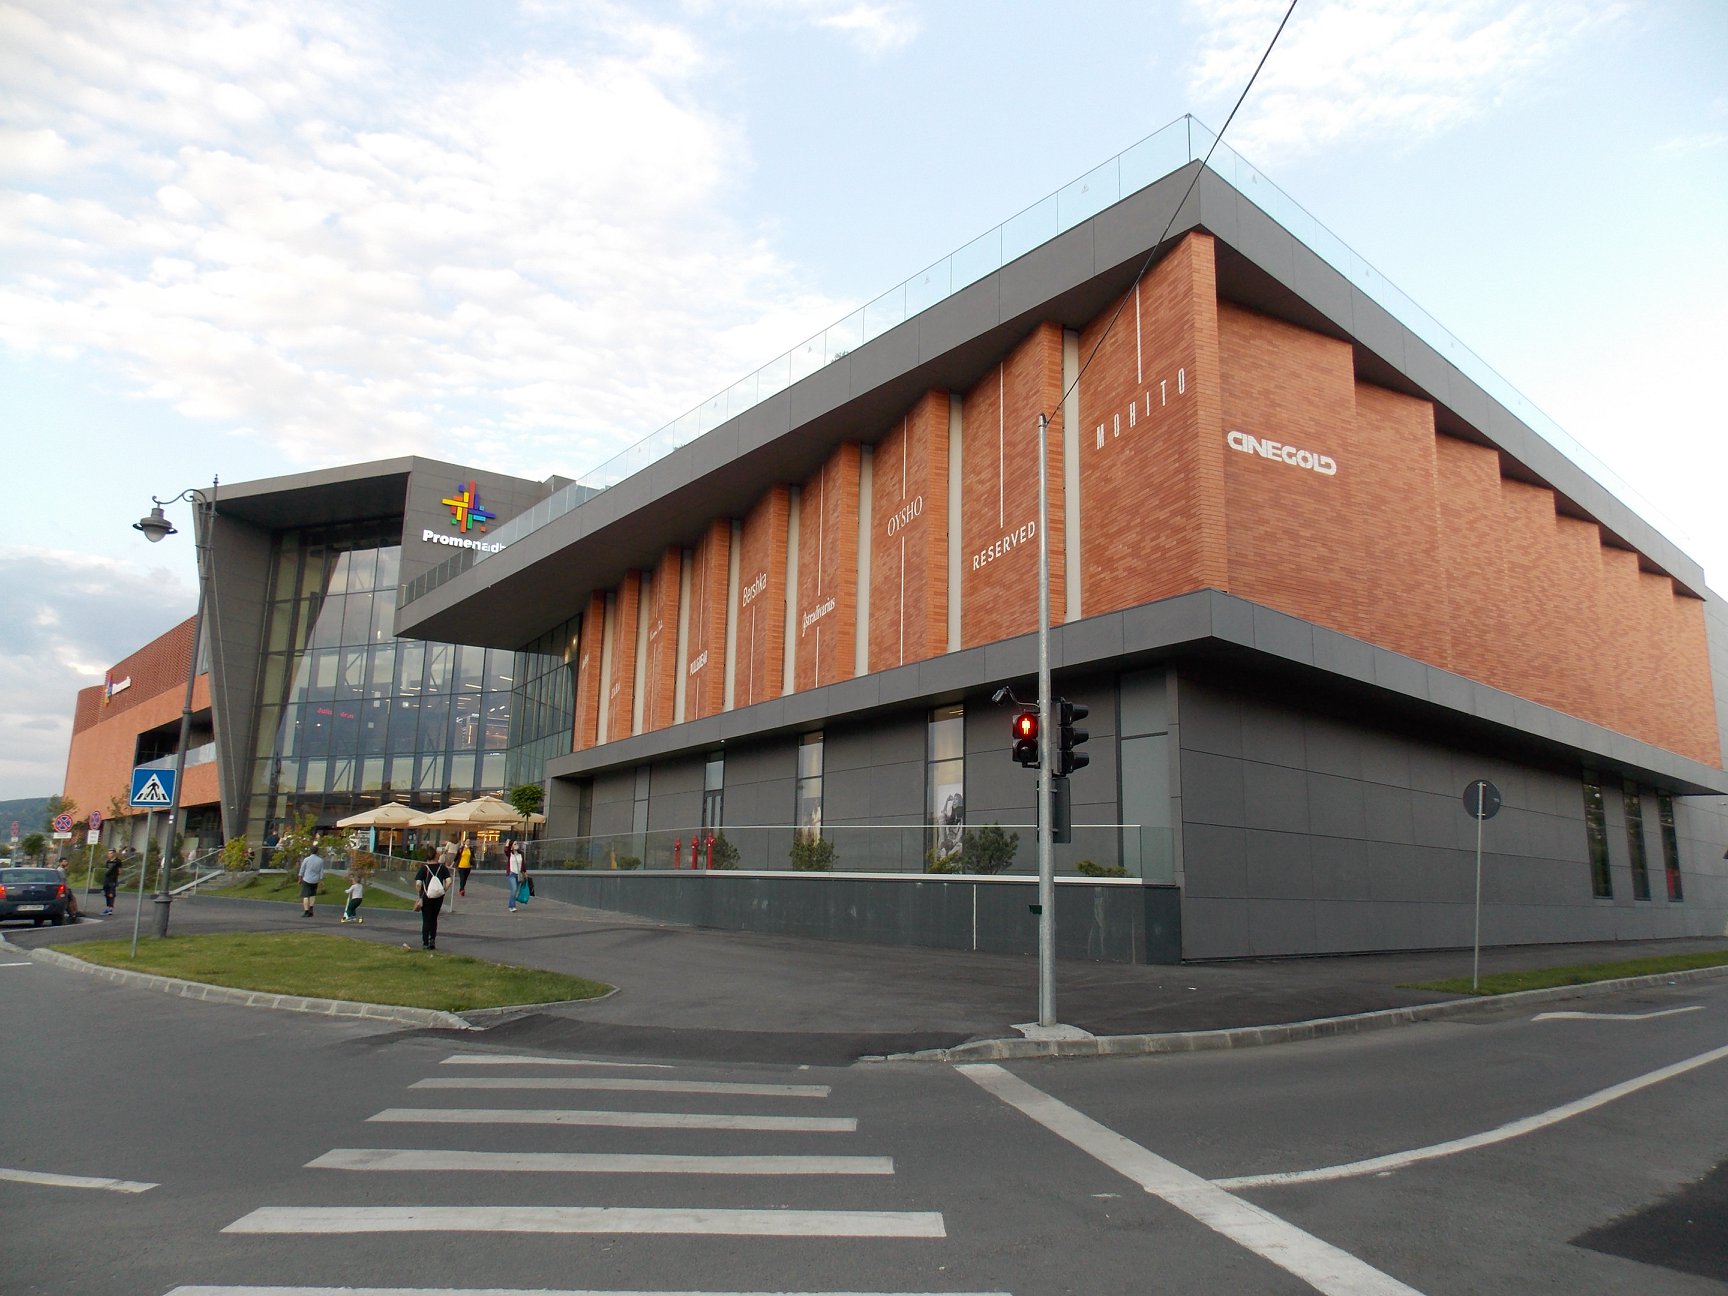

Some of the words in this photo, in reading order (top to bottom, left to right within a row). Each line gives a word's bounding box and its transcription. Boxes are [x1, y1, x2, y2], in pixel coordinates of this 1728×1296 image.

[1096, 367, 1186, 450] MOHITO
[1226, 430, 1337, 476] CINEGOLD
[887, 495, 924, 537] OYSHO
[972, 520, 1036, 571] RESERVED
[742, 572, 767, 608] Bershka
